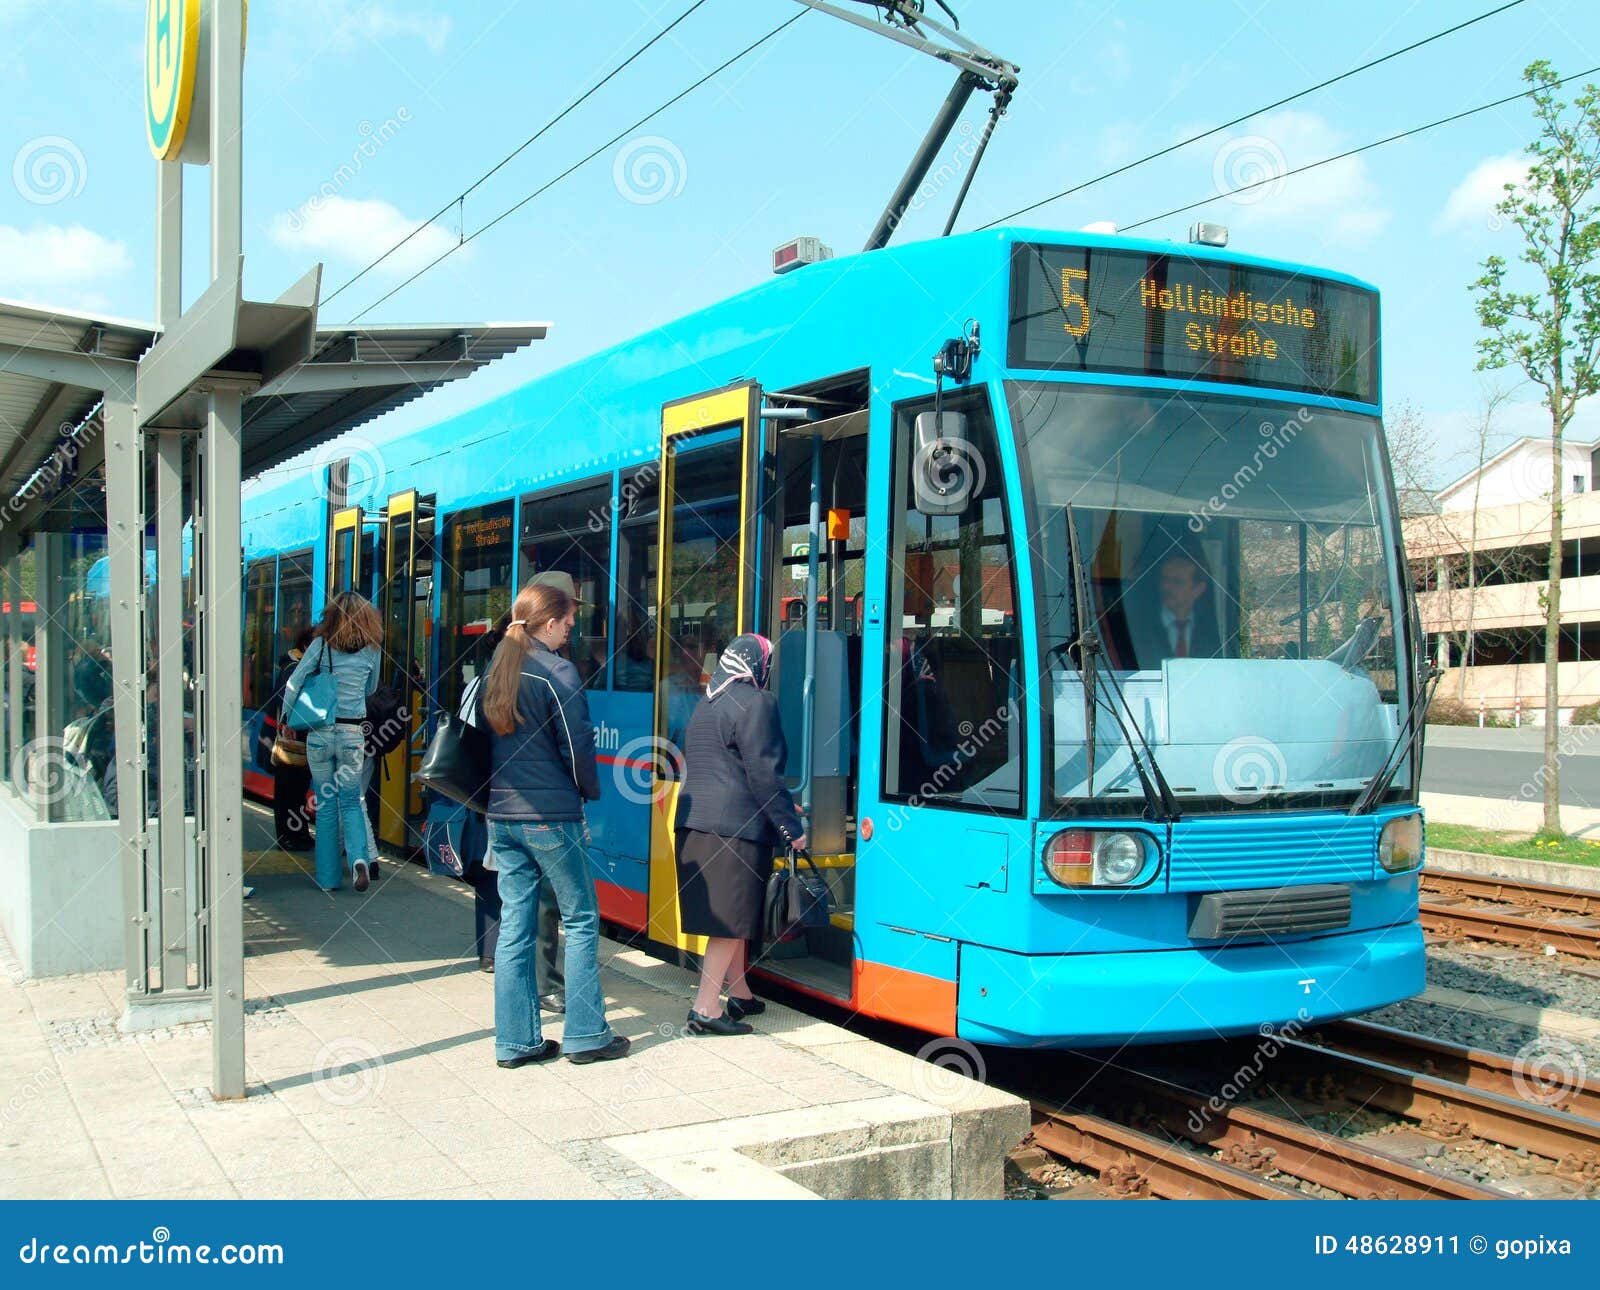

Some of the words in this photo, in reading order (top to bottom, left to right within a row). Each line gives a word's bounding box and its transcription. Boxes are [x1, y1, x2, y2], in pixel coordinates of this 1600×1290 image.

[1061, 268, 1090, 337] 5
[1139, 278, 1316, 328] Holländische
[1185, 322, 1278, 359] Straße
[593, 719, 619, 750] ahn
